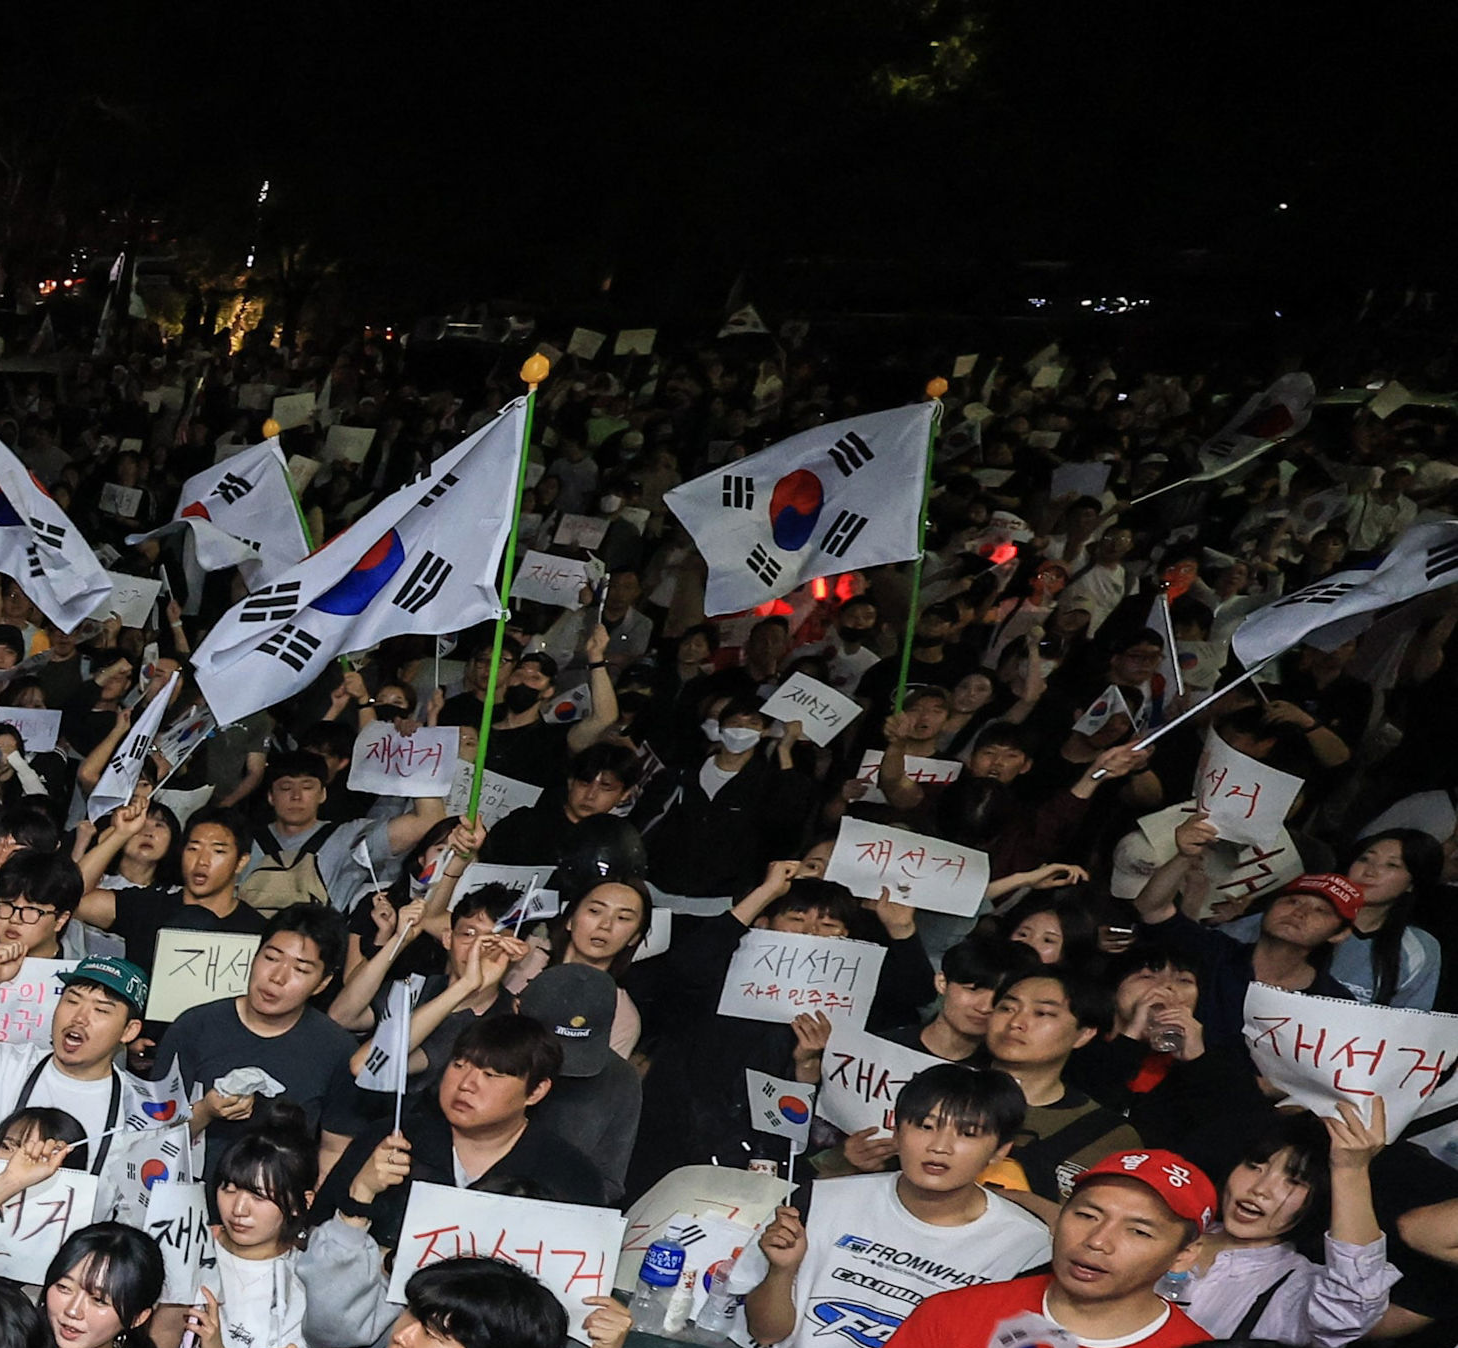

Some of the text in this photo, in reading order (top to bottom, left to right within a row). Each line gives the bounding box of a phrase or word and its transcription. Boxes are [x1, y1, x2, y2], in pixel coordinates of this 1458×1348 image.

[781, 685, 839, 727] 재선거
[366, 733, 442, 778] 재선거
[856, 839, 967, 882] 재선거
[168, 944, 252, 993] 재선
[752, 943, 862, 991] 재선거
[740, 980, 781, 1004] 자유
[1254, 1016, 1447, 1098] 재선거
